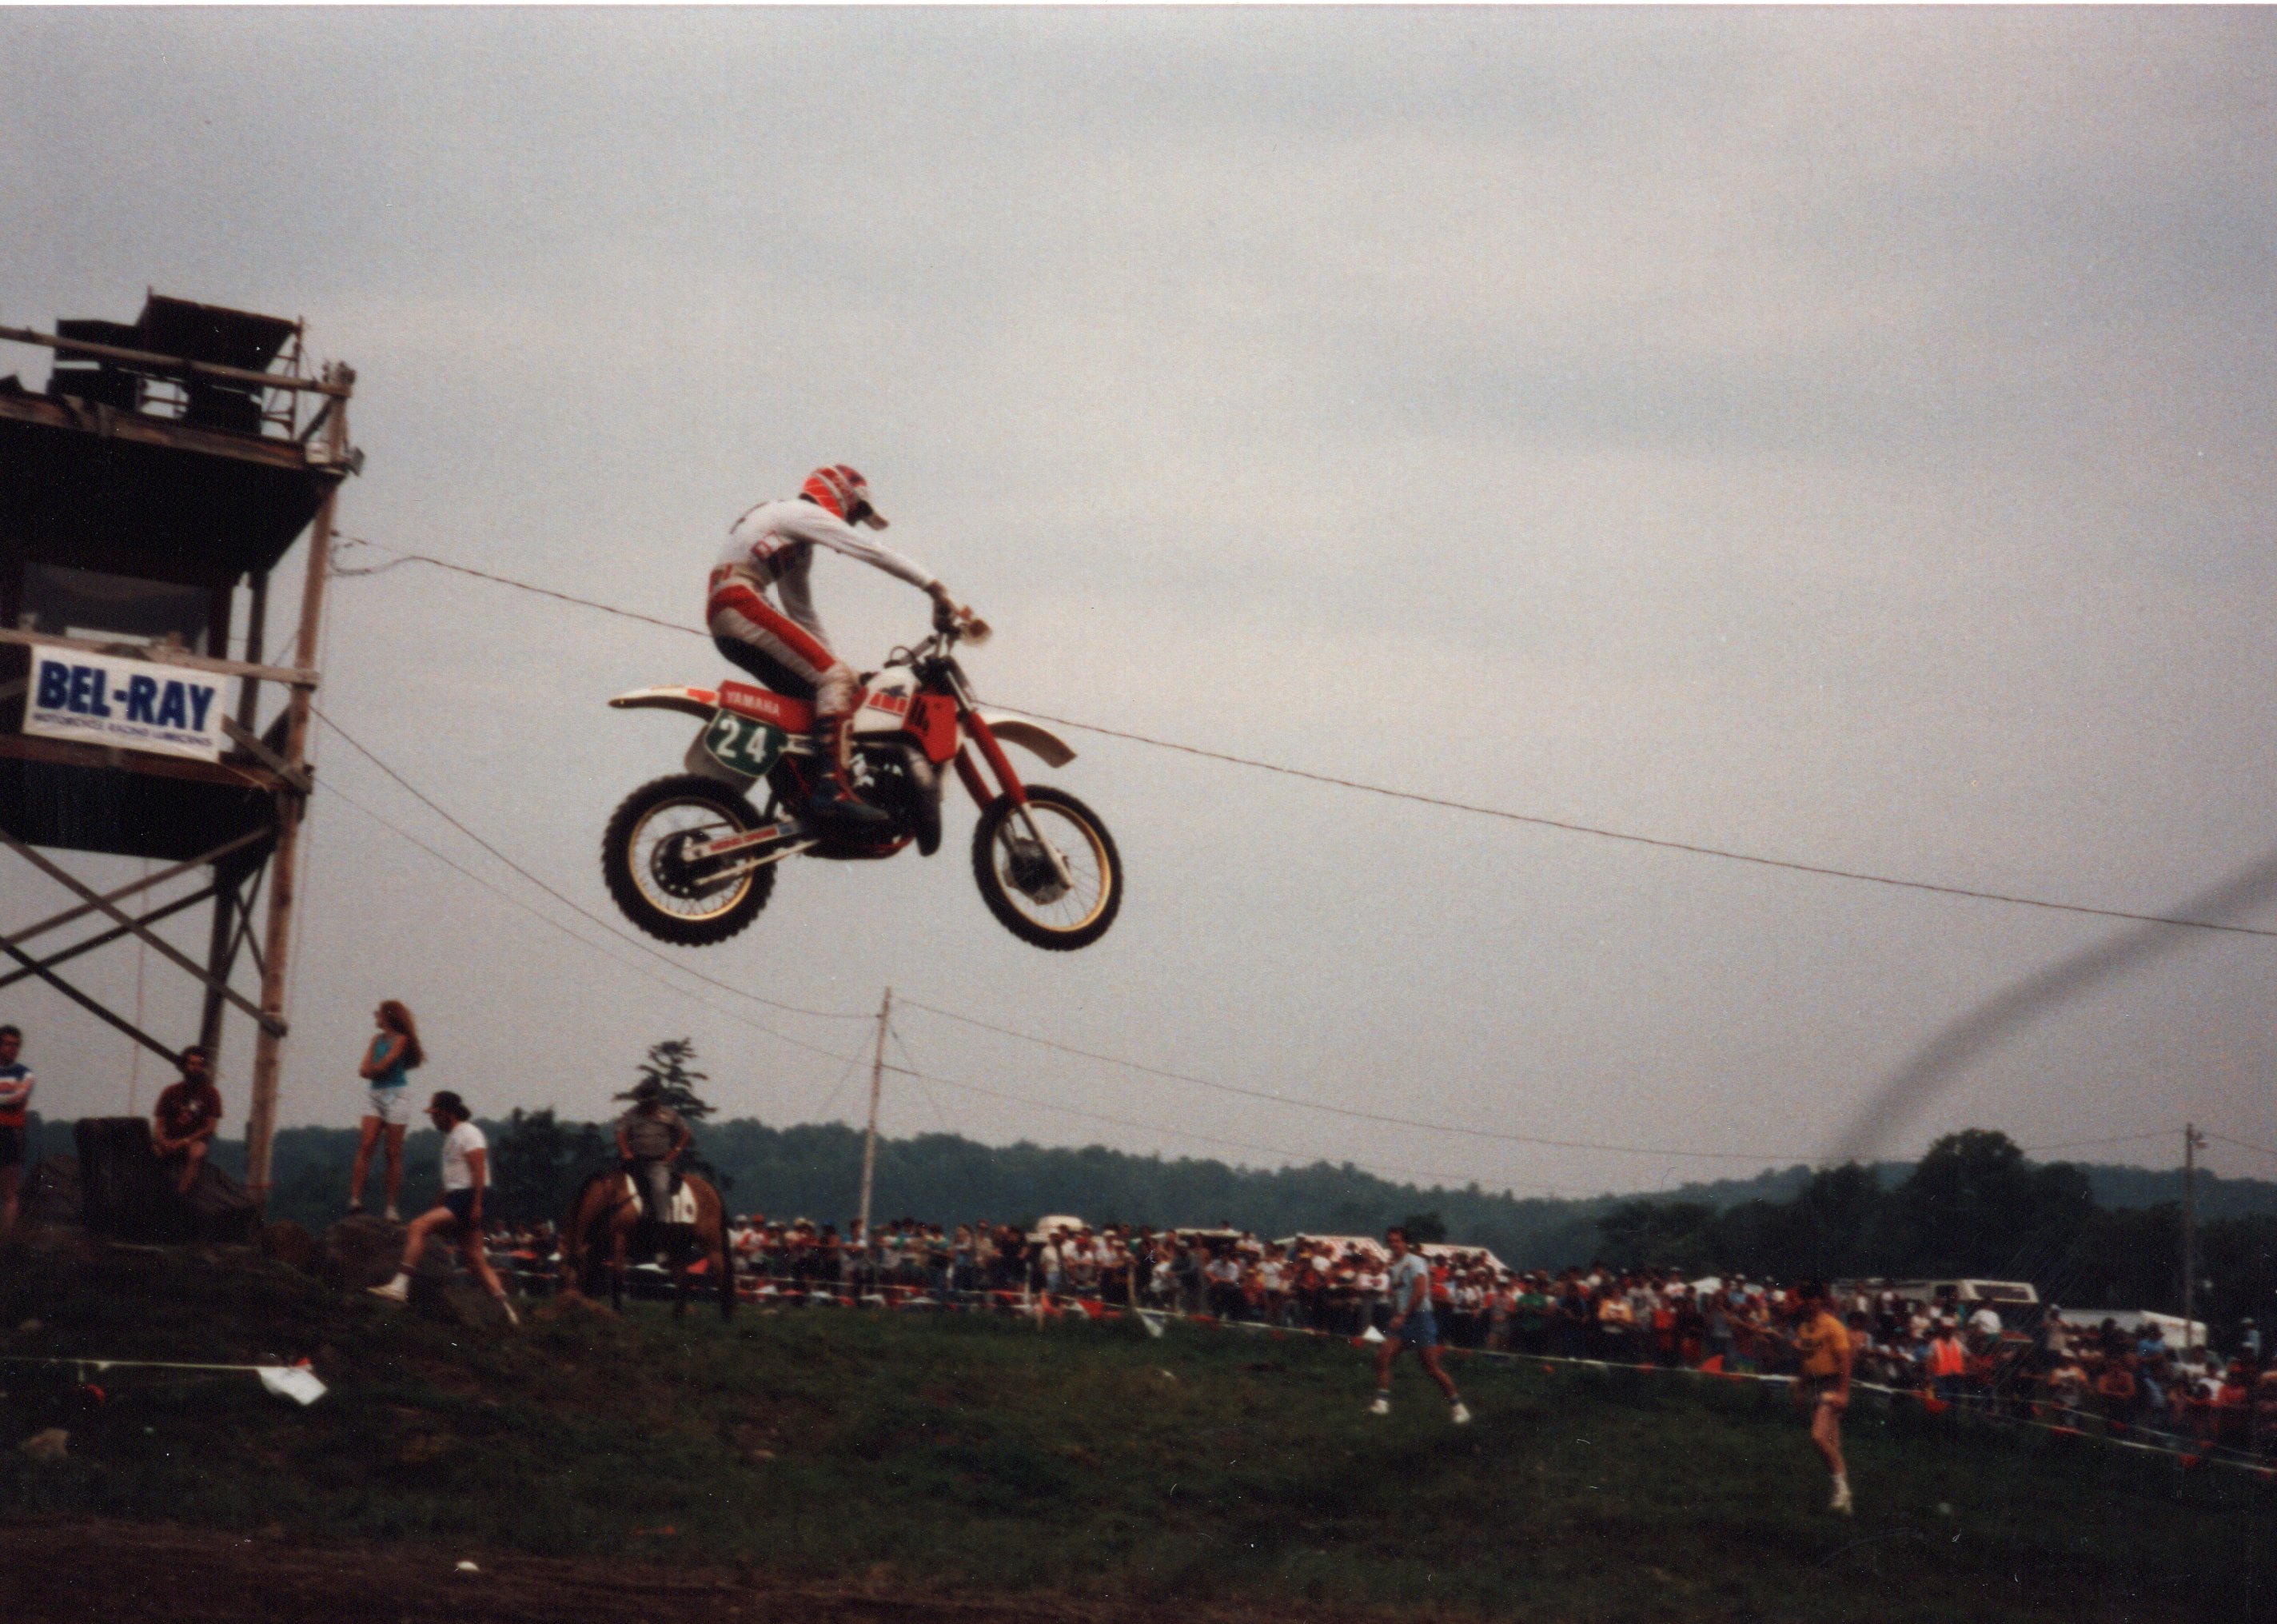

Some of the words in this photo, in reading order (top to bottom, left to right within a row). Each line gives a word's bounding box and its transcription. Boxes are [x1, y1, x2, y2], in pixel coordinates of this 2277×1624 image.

[38, 660, 214, 732] BEL-RAY
[726, 691, 780, 716] YAMAHA
[717, 718, 767, 763] 24
